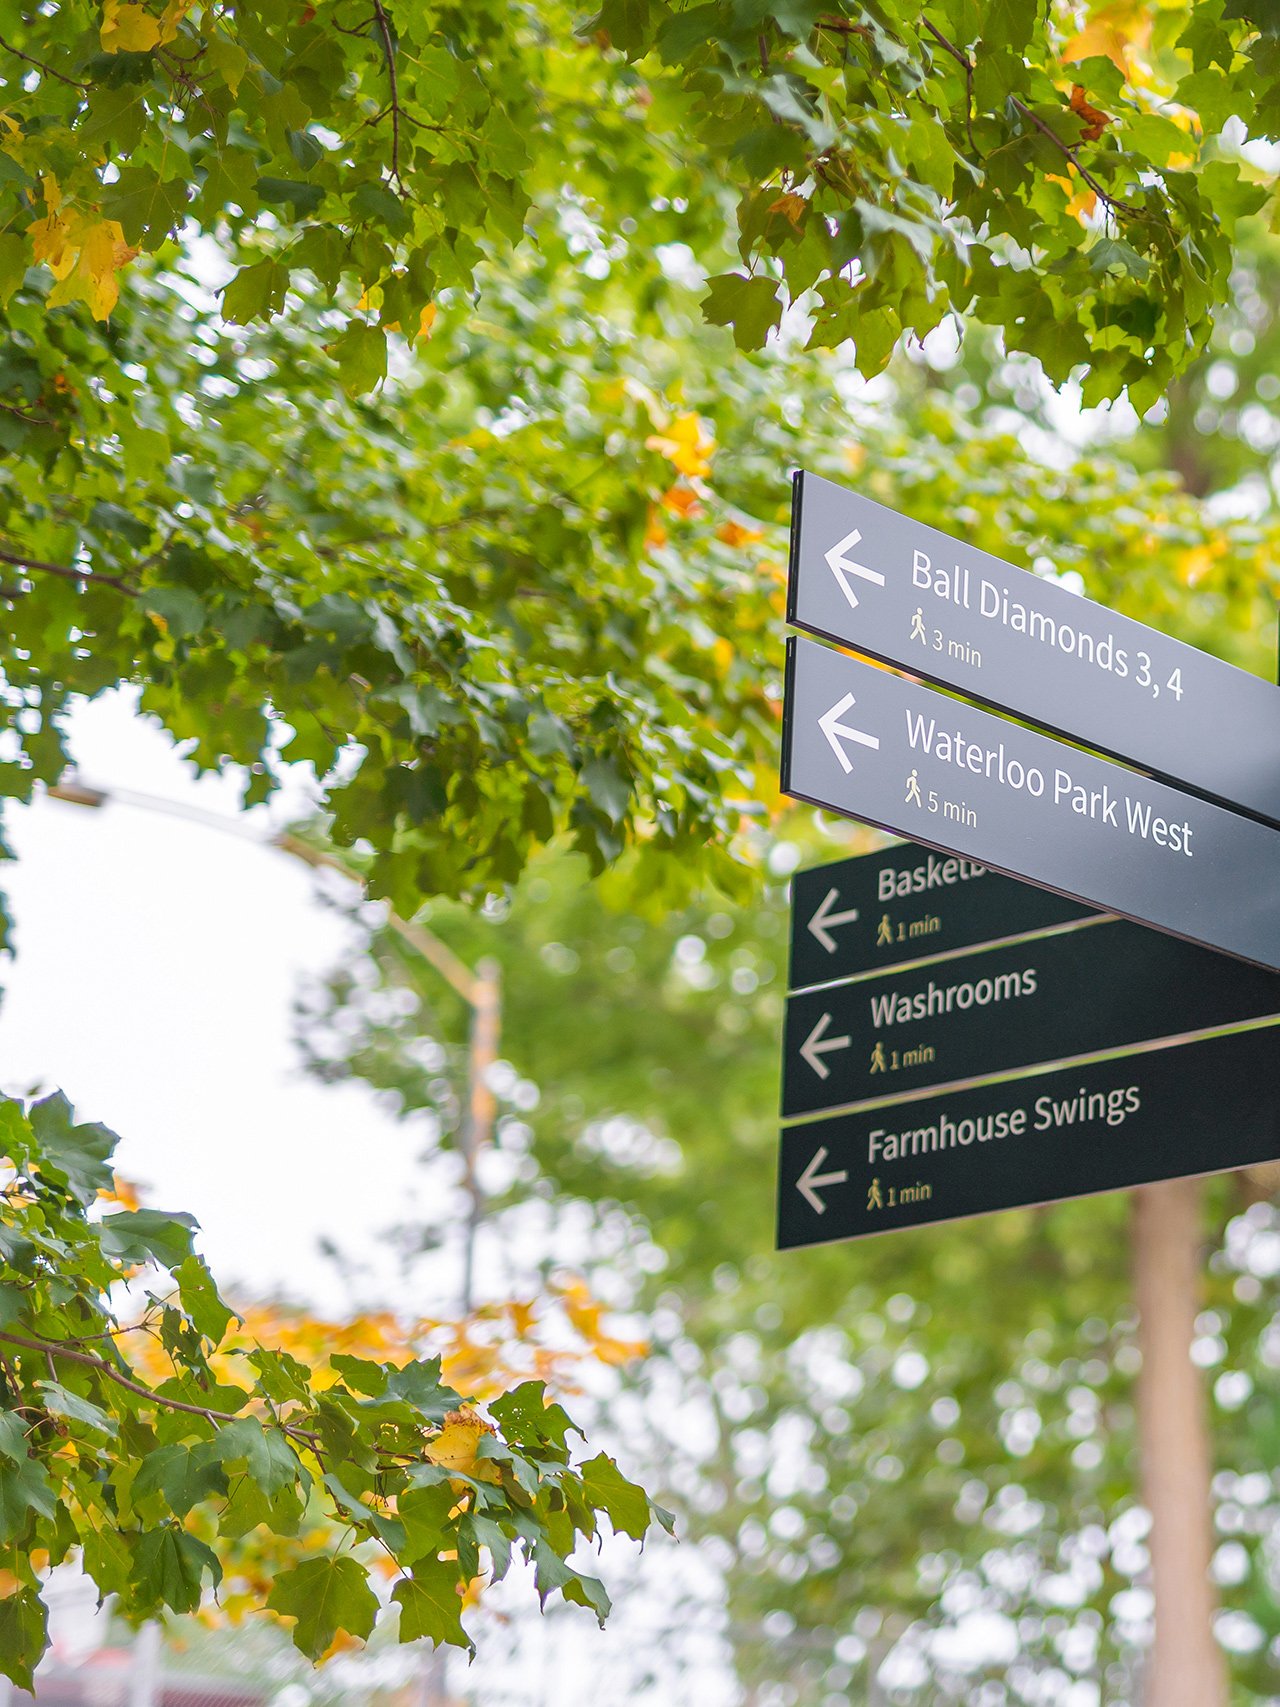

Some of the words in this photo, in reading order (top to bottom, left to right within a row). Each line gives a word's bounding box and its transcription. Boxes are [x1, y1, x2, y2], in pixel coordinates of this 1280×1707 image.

[912, 549, 970, 608] Ball
[980, 579, 1130, 678] Diamonds
[1136, 651, 1160, 699] 3,
[1166, 667, 1184, 702] 4
[932, 629, 943, 651] 3
[948, 639, 982, 668] min
[905, 708, 1046, 798] Waterloo
[1054, 769, 1118, 828] Park
[1125, 796, 1193, 857] West
[927, 790, 938, 813] 5
[943, 799, 977, 828] min
[896, 922, 906, 942] 1
[909, 914, 941, 938] min
[870, 967, 1037, 1028] Washrooms
[890, 1050, 899, 1070] 1
[902, 1044, 935, 1066] min
[868, 1107, 1027, 1164] Farmhouse
[1033, 1085, 1140, 1131] Swings
[887, 1187, 896, 1207] 1
[899, 1180, 931, 1203] min
